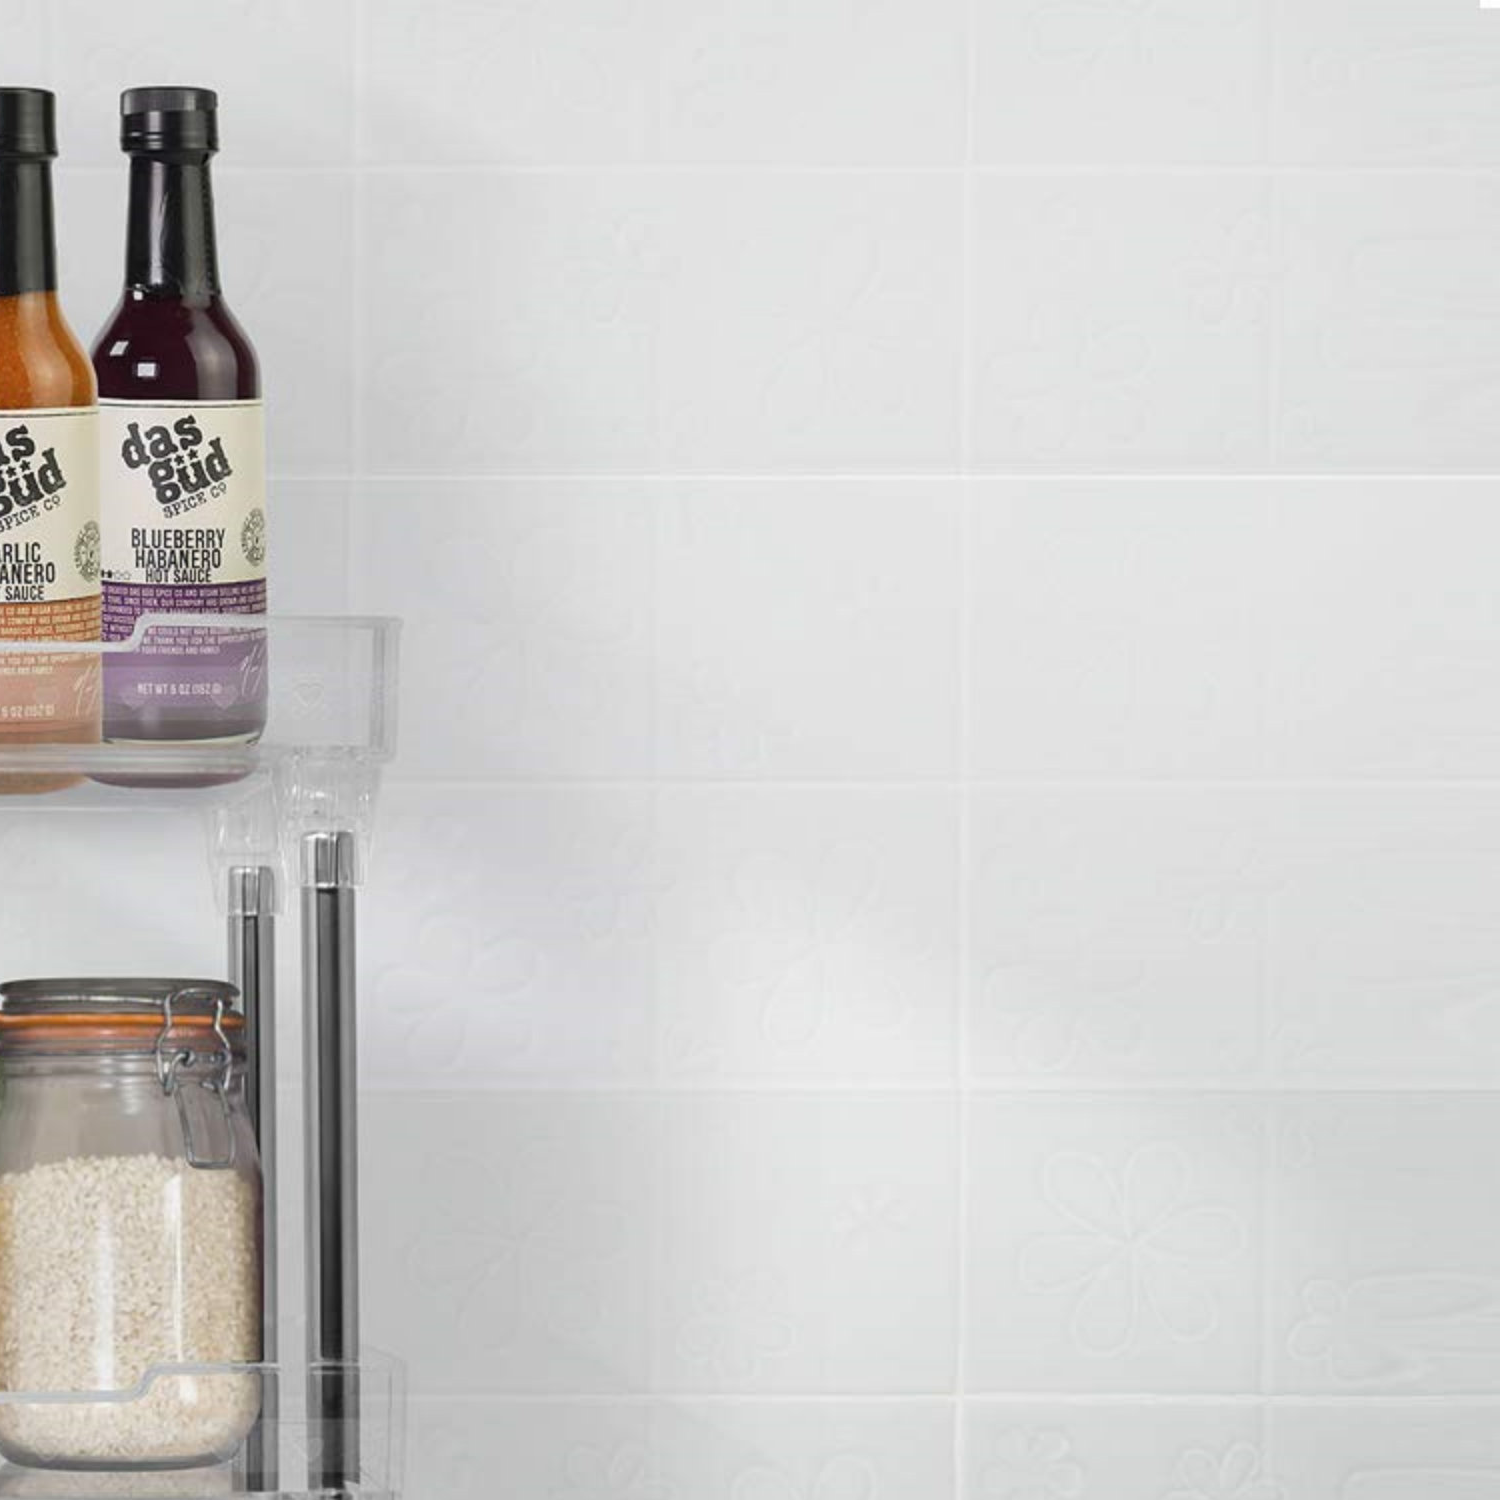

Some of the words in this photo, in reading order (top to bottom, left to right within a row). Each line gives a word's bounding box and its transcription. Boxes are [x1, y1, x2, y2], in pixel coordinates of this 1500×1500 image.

[121, 414, 203, 469] das
[163, 491, 208, 519] SPICE
[131, 527, 226, 549] BLUEBERRY
[135, 549, 222, 569] HABANERO
[145, 569, 170, 584] HOT
[173, 569, 212, 584] SAUCE
[5, 585, 45, 601] SAUCE
